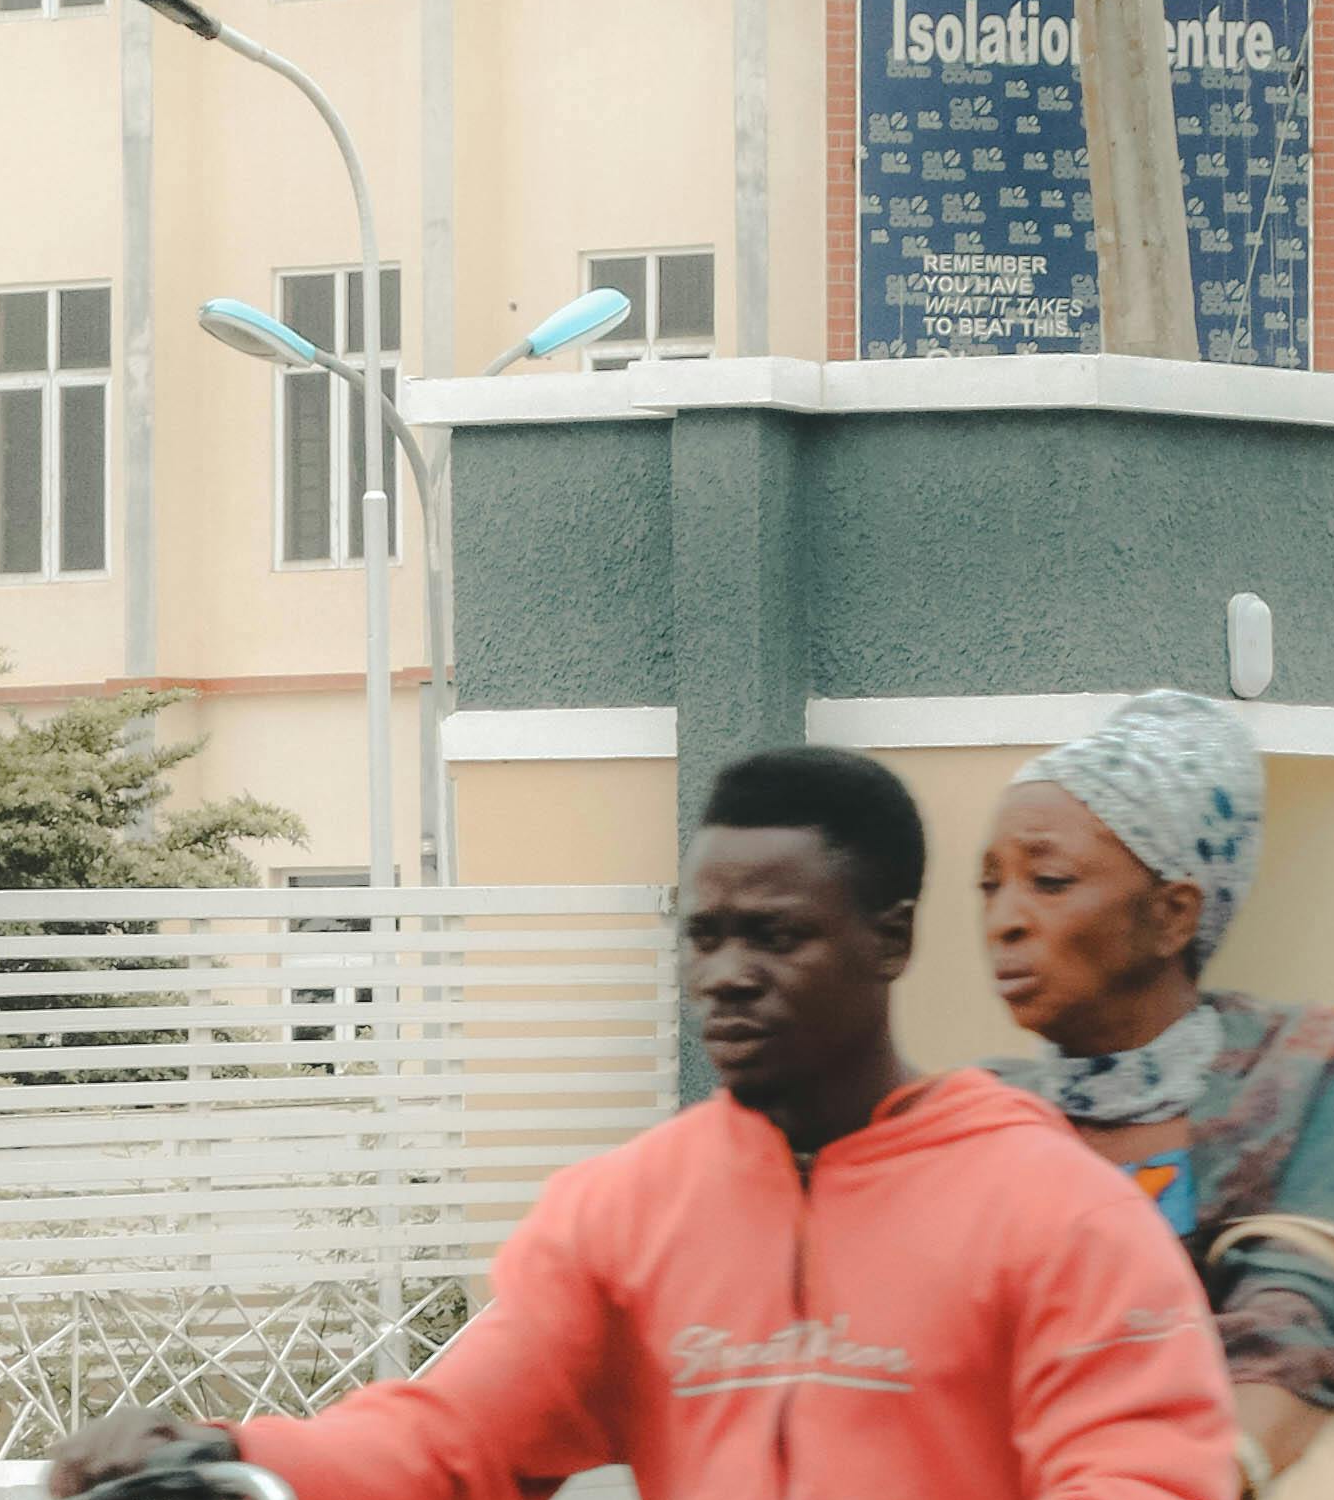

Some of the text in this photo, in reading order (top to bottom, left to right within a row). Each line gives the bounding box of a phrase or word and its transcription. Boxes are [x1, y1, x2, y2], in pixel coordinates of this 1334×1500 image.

[923, 254, 1048, 275] REMEMBER
[923, 275, 1034, 294] YOU HAVE
[925, 296, 1083, 317] WHAT IT TAKES
[923, 316, 953, 335] TO
[959, 317, 1014, 336] BEAT
